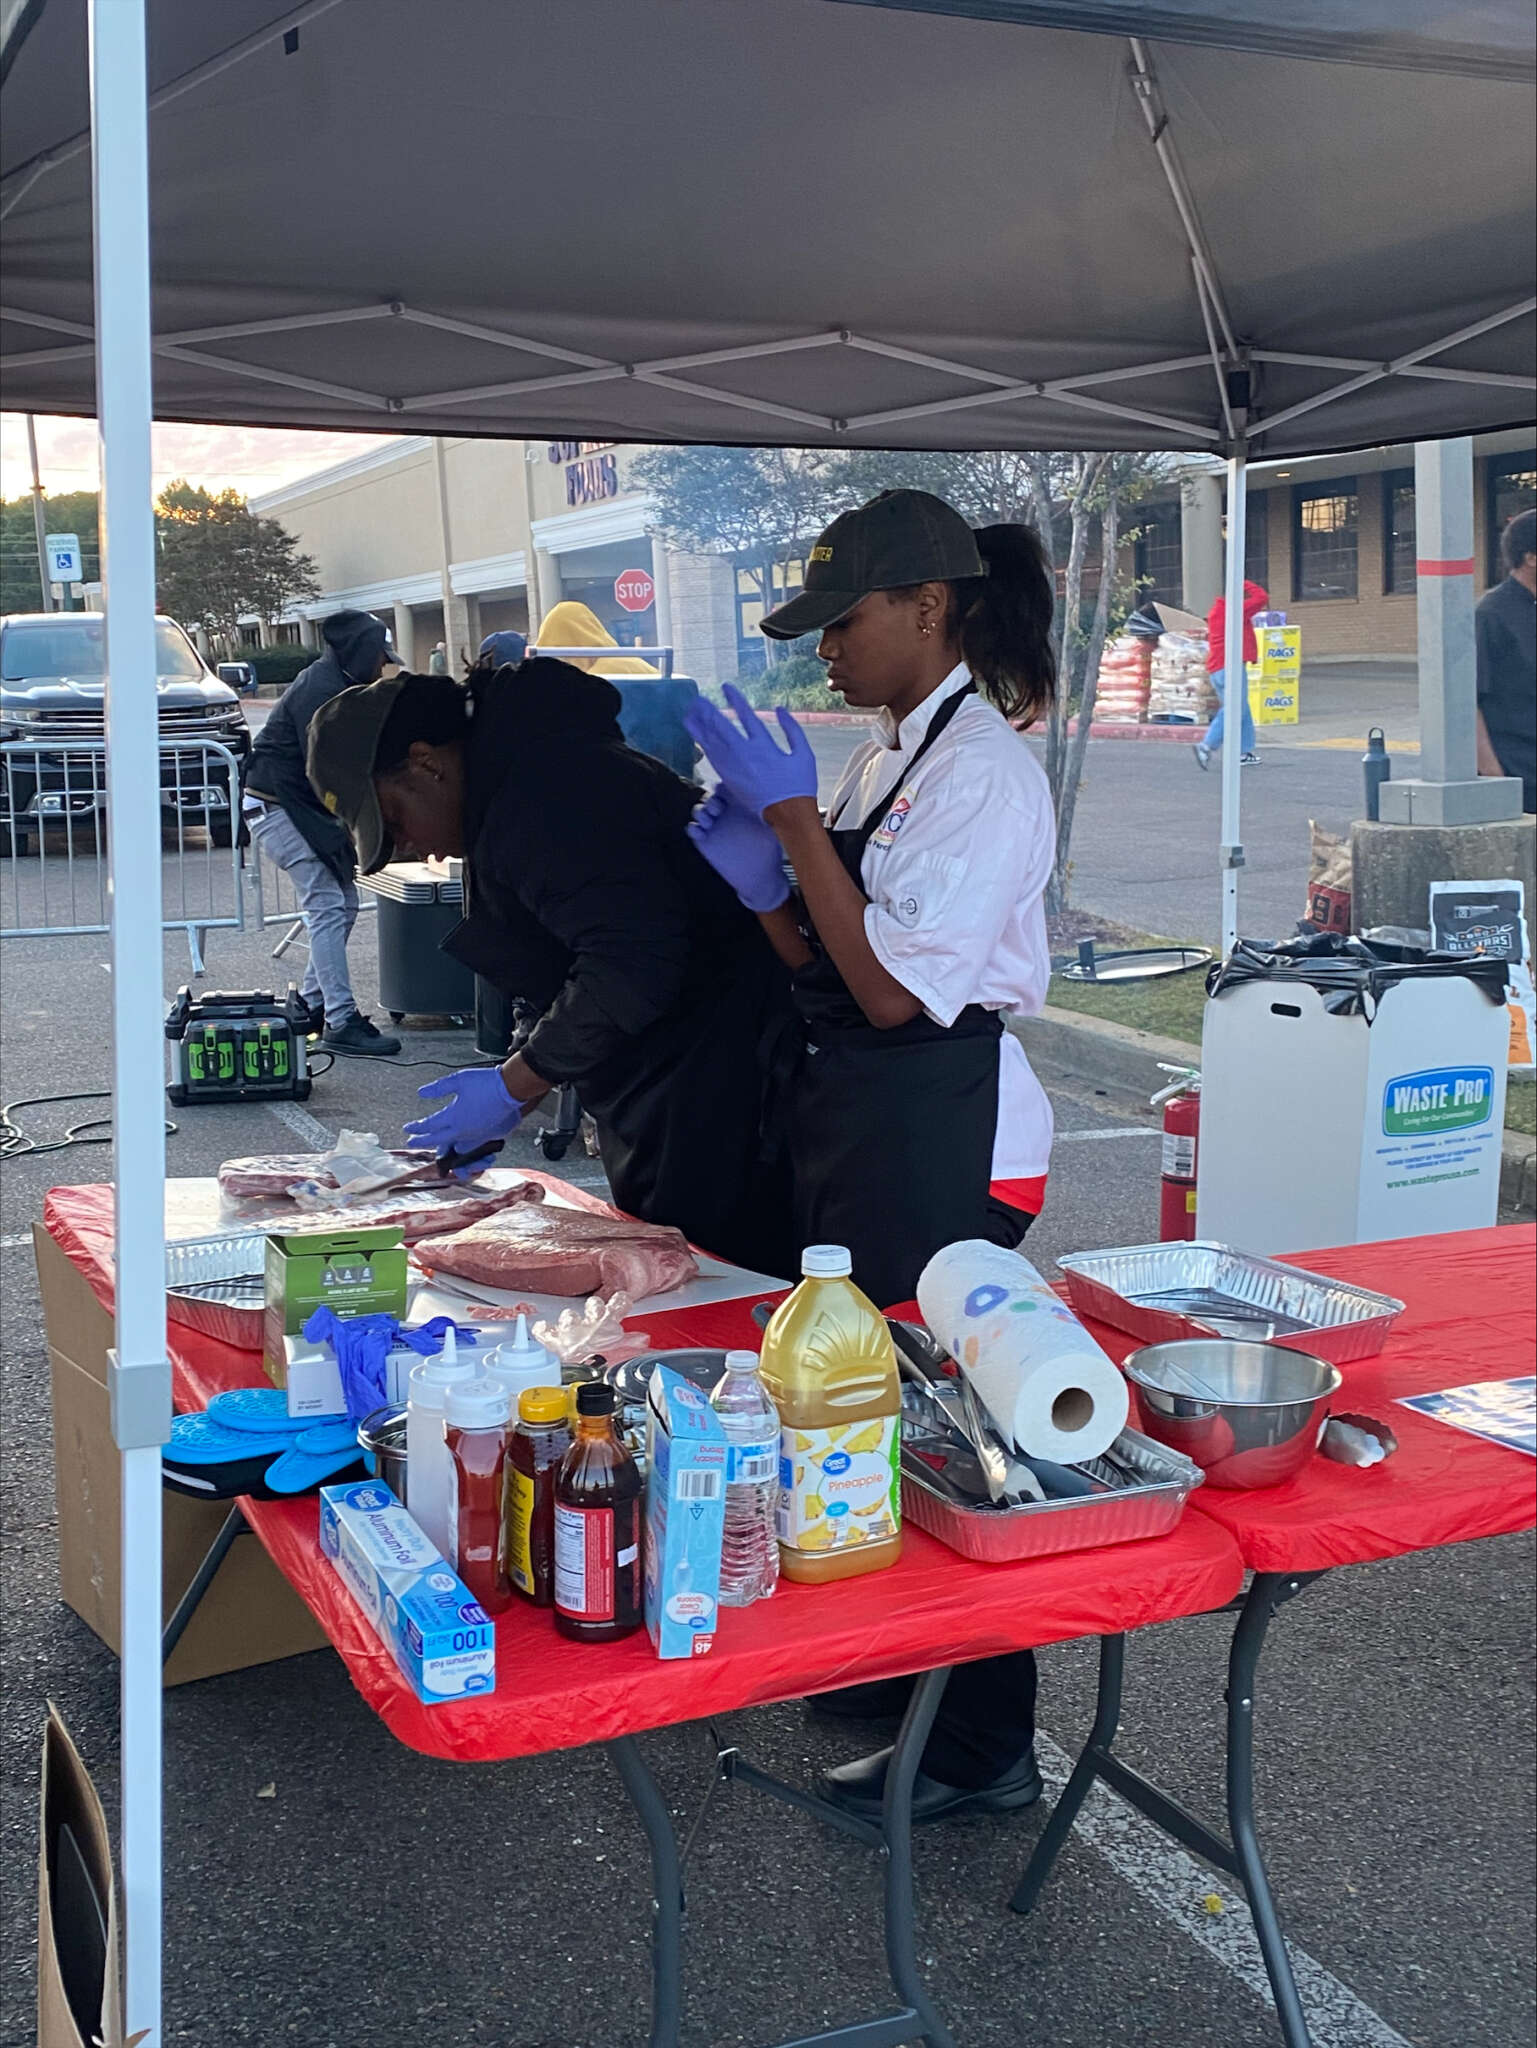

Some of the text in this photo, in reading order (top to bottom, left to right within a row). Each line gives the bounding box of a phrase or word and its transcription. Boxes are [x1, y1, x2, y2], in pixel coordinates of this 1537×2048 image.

[619, 582, 652, 599] STOP
[1267, 647, 1296, 659] RAGS
[1264, 696, 1294, 708] RAGS
[1448, 934, 1509, 951] ALLSTARS
[1393, 1078, 1485, 1115] WASTE PRO
[828, 1472, 884, 1492] Pineapple
[368, 1513, 404, 1554] Aluminum
[453, 1628, 488, 1651] 100
[694, 1642, 712, 1654] 48
[446, 1652, 488, 1667] Aluminum
